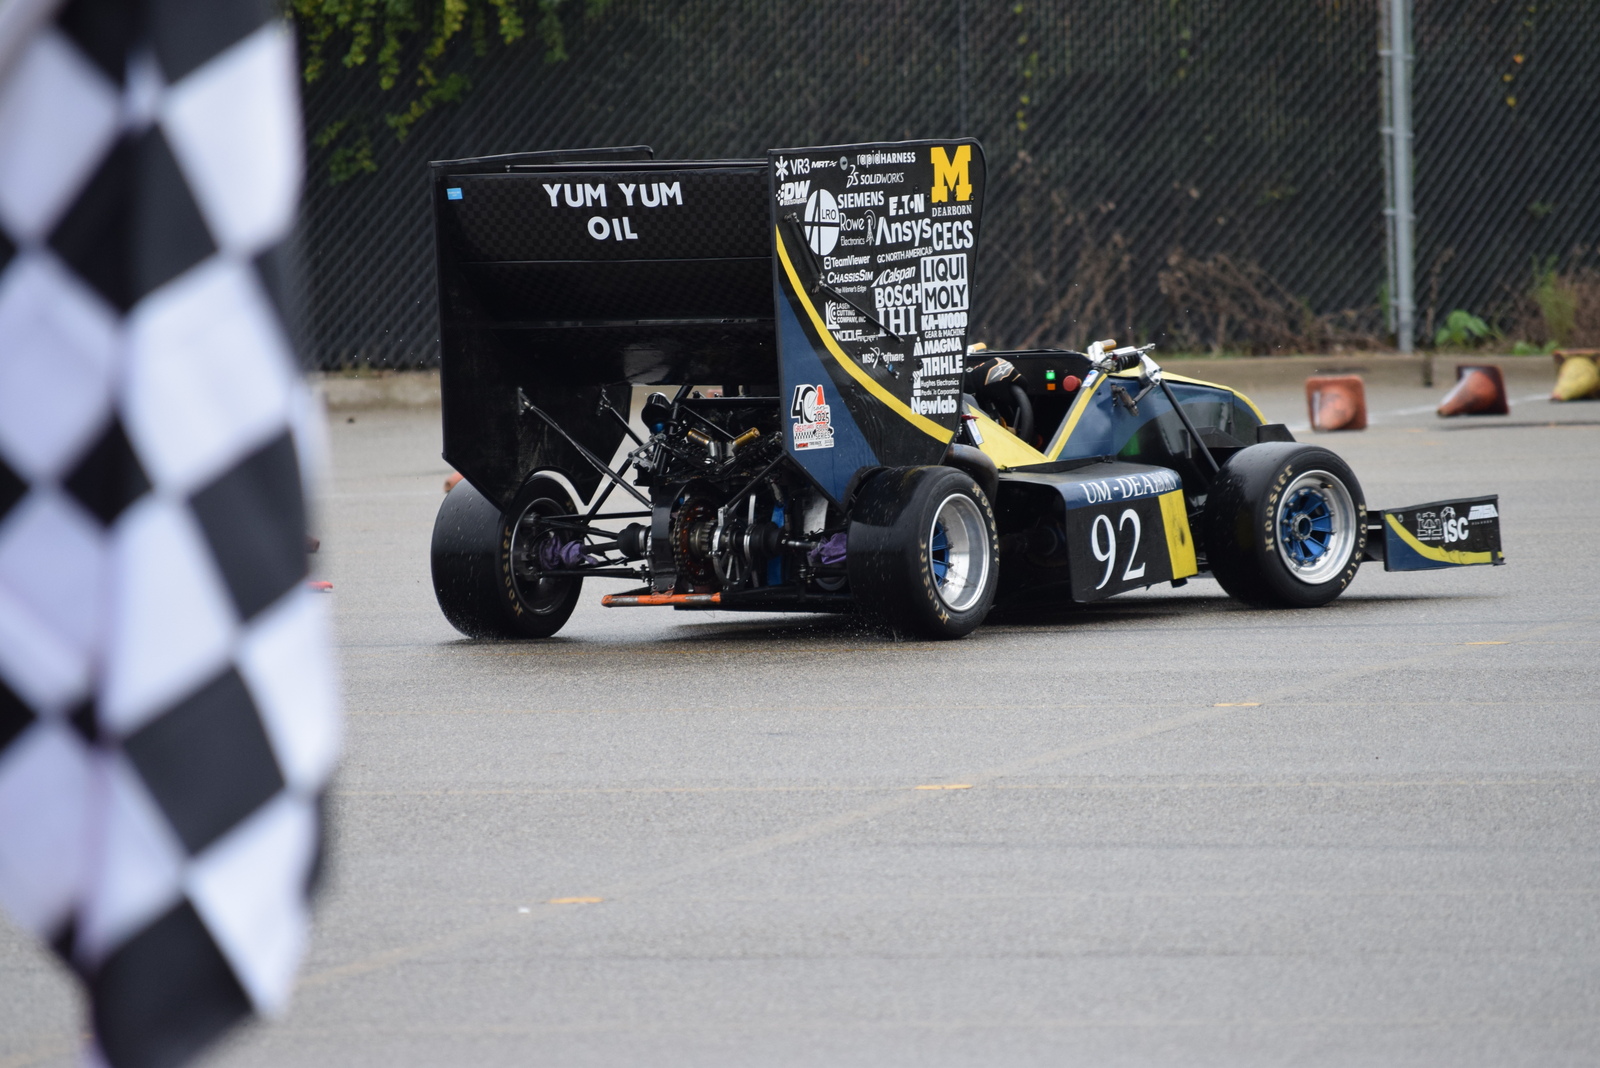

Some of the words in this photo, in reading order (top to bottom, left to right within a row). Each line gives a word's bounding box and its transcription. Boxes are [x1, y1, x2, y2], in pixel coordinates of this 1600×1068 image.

[790, 158, 811, 175] VR3
[857, 150, 916, 168] rapidHARNESS
[860, 172, 905, 185] SOLIDWORKS
[930, 145, 973, 203] M
[542, 183, 607, 207] YUM
[618, 182, 683, 207] YUM
[783, 180, 811, 201] DW
[837, 190, 884, 209] SIEMENS
[931, 204, 973, 217] DEARBORN
[587, 216, 638, 241] OIL
[840, 212, 865, 232] Rowe
[841, 235, 866, 246] Electronics
[875, 216, 932, 247] Ansys
[932, 220, 974, 251] CECS
[831, 255, 871, 268] TeamViewer
[877, 254, 886, 264] GC
[886, 250, 905, 262] NORTH
[905, 246, 929, 259] AMERICA
[884, 266, 916, 284] Calspan
[923, 256, 965, 283] LIQUI
[874, 282, 922, 309] BOSCH
[923, 284, 967, 311] MOLY
[836, 309, 856, 317] CUTTING
[876, 305, 918, 337] IHI
[921, 311, 968, 331] KA-WOOD
[924, 330, 938, 339] GEAR
[943, 328, 966, 337] MACHINE
[924, 337, 962, 355] MAGNA
[862, 352, 875, 364] MSC
[936, 378, 960, 387] Electronics
[937, 387, 960, 396] Corporation
[910, 395, 957, 415] Newlab
[813, 412, 830, 424] 2025
[1091, 508, 1146, 590] 92
